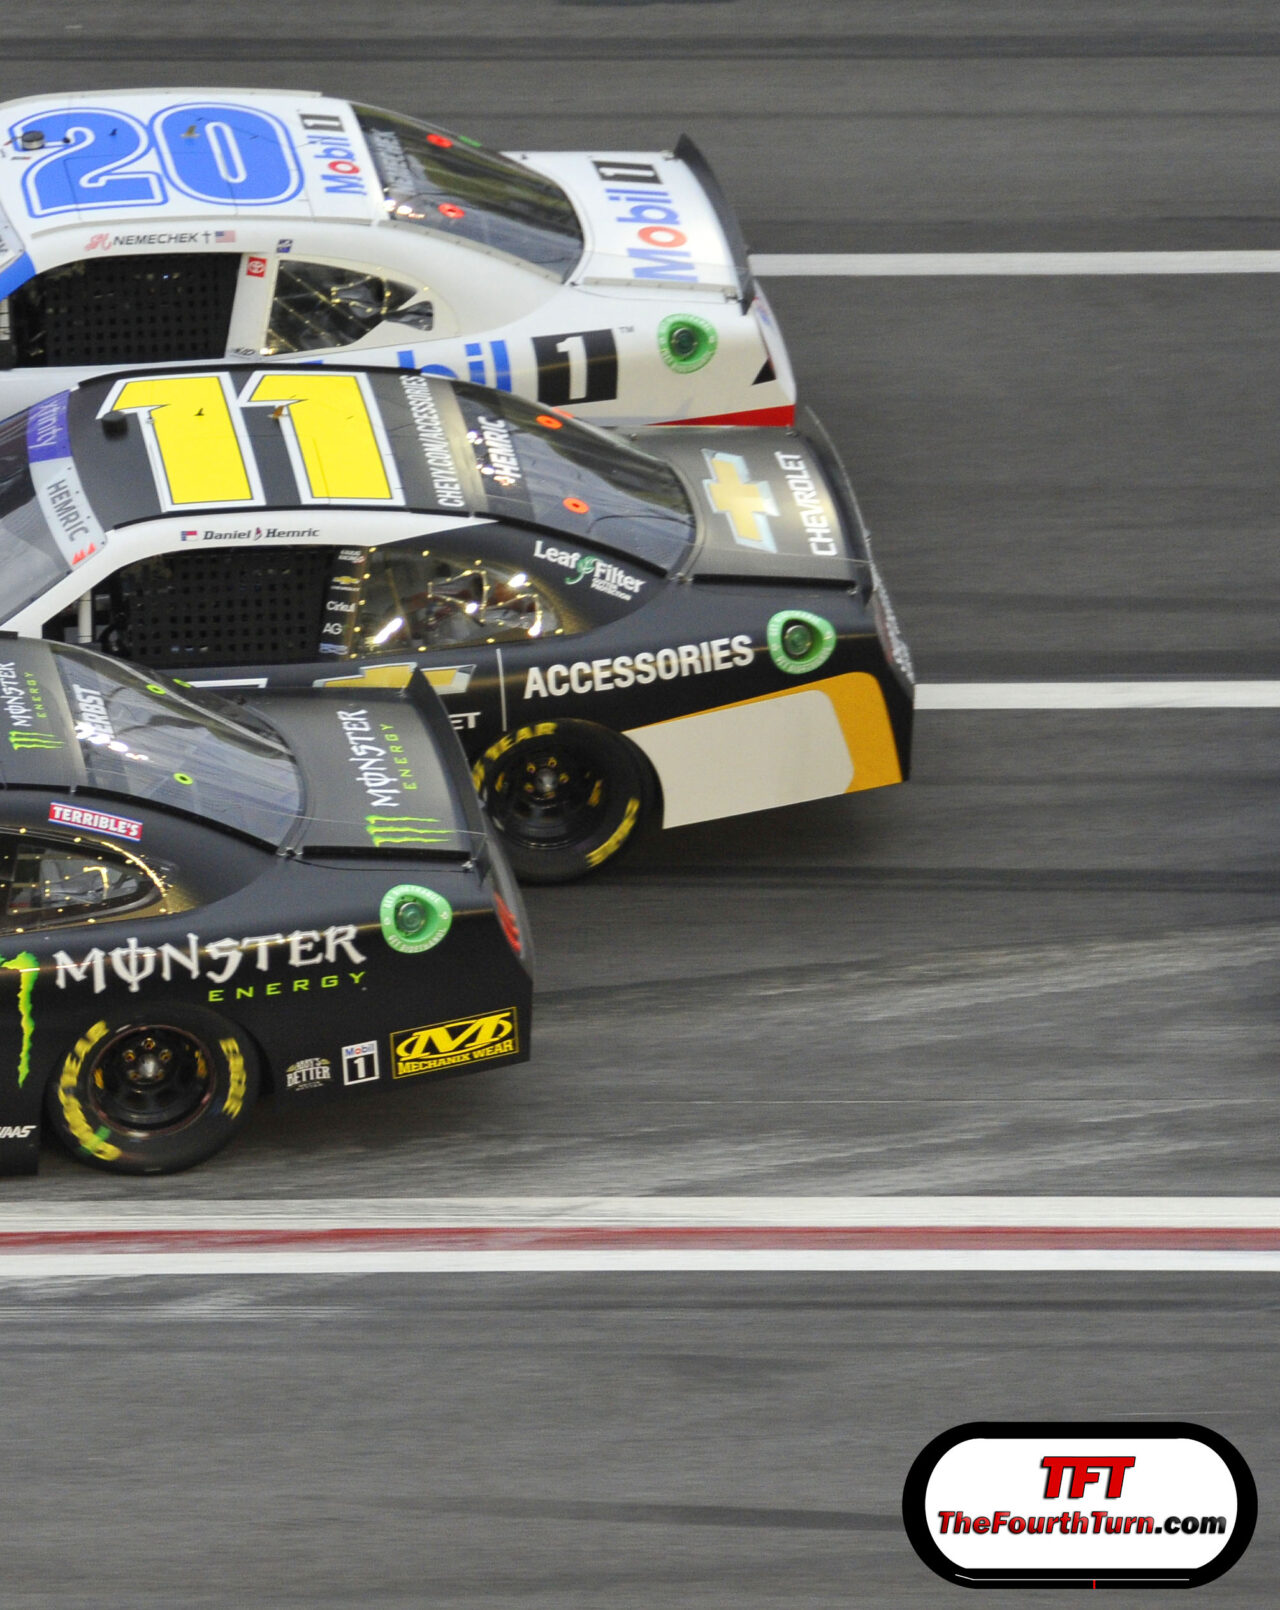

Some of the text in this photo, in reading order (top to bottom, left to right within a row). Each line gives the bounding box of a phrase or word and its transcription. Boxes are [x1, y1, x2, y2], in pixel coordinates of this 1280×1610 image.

[8, 101, 305, 218] 20
[307, 135, 368, 196] Mobil
[113, 232, 199, 246] NEMECHEK
[605, 188, 699, 283] Mobil
[554, 334, 590, 400] 1
[28, 400, 63, 449] xfinity
[96, 372, 405, 511] 11
[399, 375, 465, 507] CHEVY.COM/ACCESSORIES
[47, 478, 90, 542] HEMRIC
[202, 528, 321, 541] Daniel Hemric
[774, 450, 838, 556] CHEVROLET
[24, 672, 48, 718] ENERGY
[523, 634, 755, 700] ACCESSORIES
[336, 709, 402, 807] MONSTER
[380, 723, 418, 790] ENERGY
[53, 806, 139, 837] TERRIBLE'S
[54, 924, 367, 994] MONSTER
[208, 971, 367, 1003] ENERGY
[287, 1066, 331, 1087] BETTER
[345, 1043, 376, 1057] Mobil
[398, 1039, 514, 1076] MECHANIX WEAR
